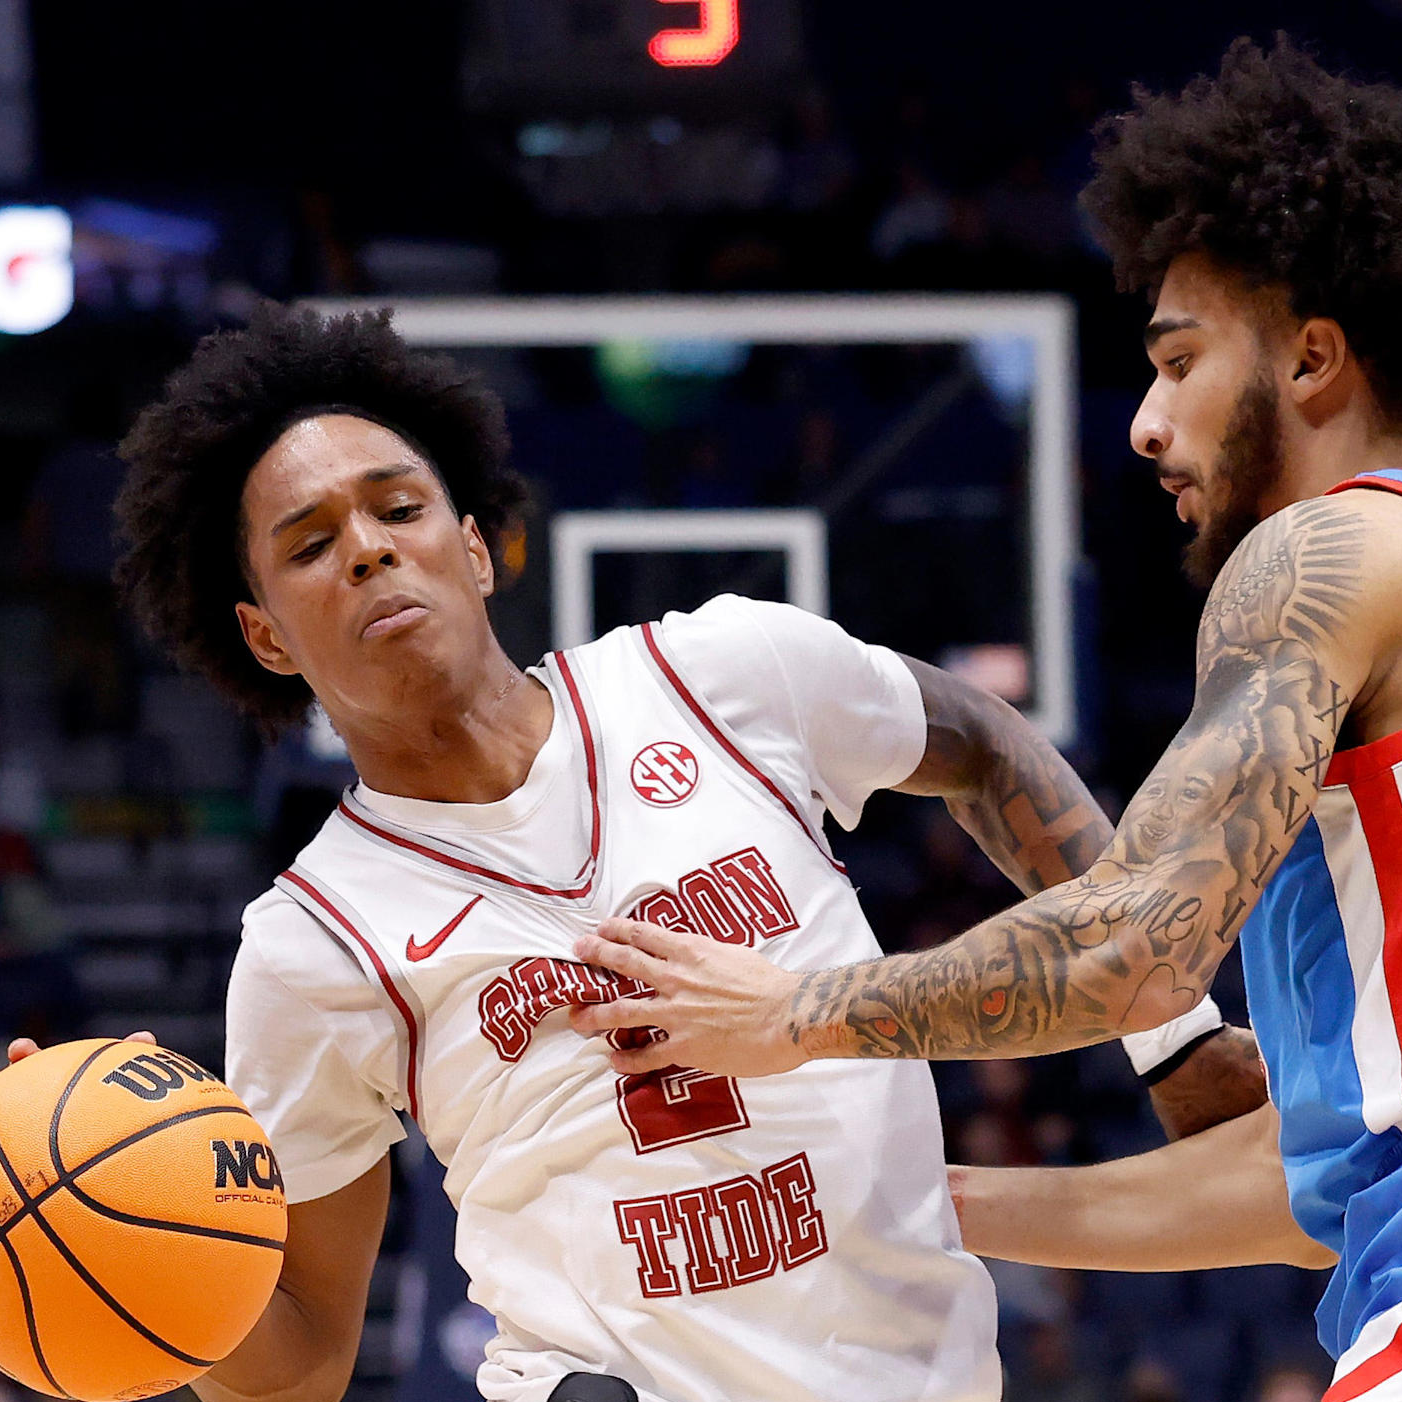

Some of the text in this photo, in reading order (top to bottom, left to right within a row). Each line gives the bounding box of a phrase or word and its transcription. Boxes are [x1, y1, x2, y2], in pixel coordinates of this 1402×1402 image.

[631, 742, 698, 804] SEC
[478, 846, 800, 1063] CRISON
[215, 1194, 265, 1204] OFFICIAL
[613, 1151, 829, 1298] TIDE
